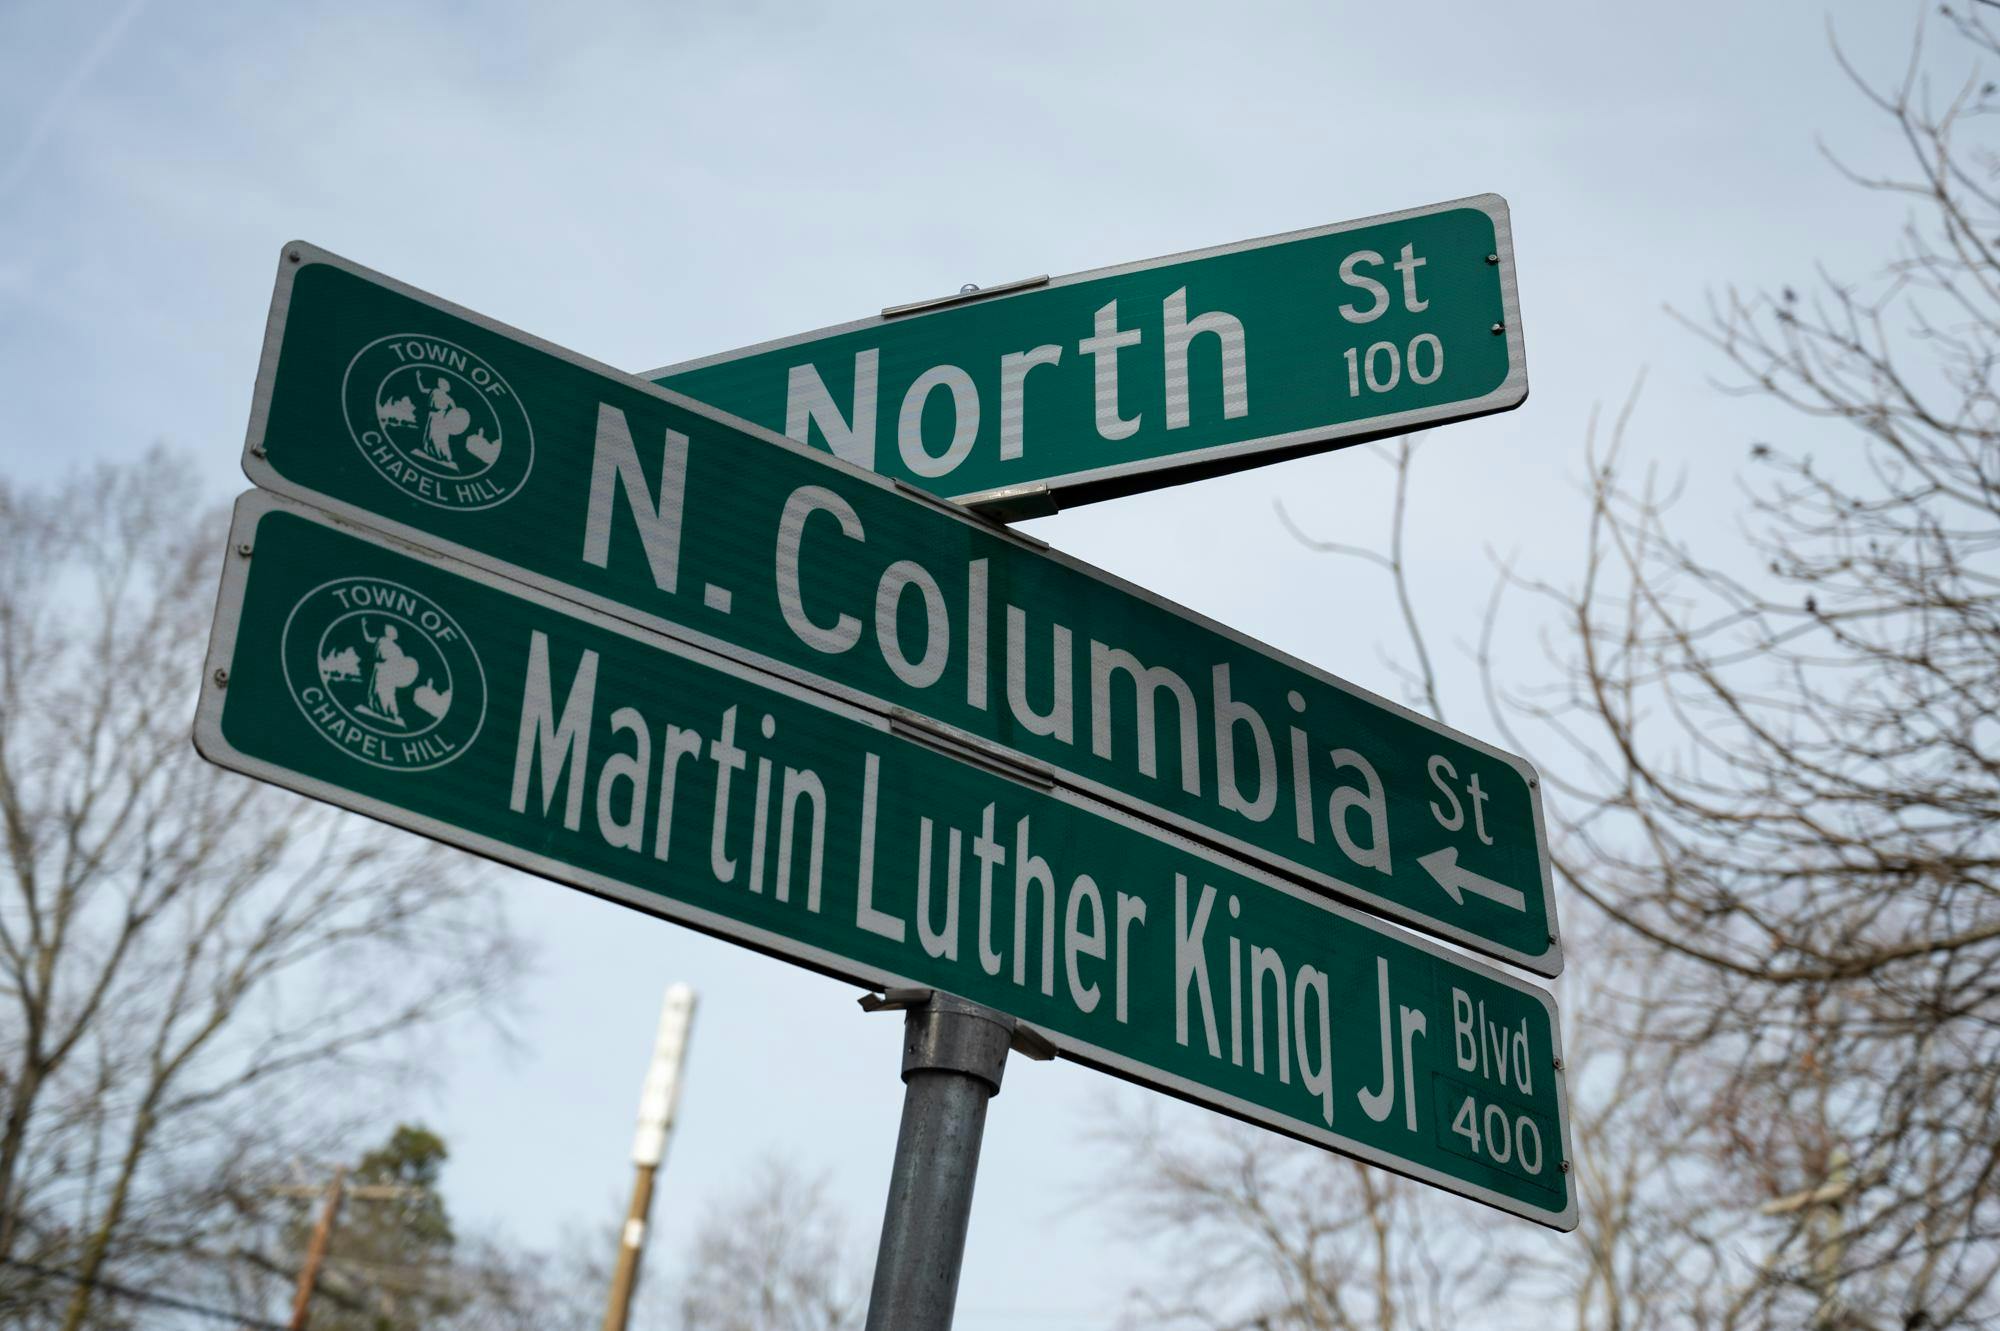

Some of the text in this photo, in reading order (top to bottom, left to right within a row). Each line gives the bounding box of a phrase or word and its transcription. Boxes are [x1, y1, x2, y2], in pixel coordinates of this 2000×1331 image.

[388, 341, 507, 397] TOWN OF
[784, 243, 1430, 478] North St
[1343, 333, 1444, 397] 100
[362, 431, 505, 503] CHAPEL HILL
[332, 585, 458, 642] TOWN OF
[583, 402, 1494, 876] N. Columbia St
[302, 687, 455, 763] CHAPEL HILL
[510, 630, 826, 914] Martin
[856, 752, 1147, 1023] Luther
[1356, 956, 1427, 1133] Jr
[1451, 986, 1533, 1097] Blvd
[1451, 1095, 1543, 1175] 400
